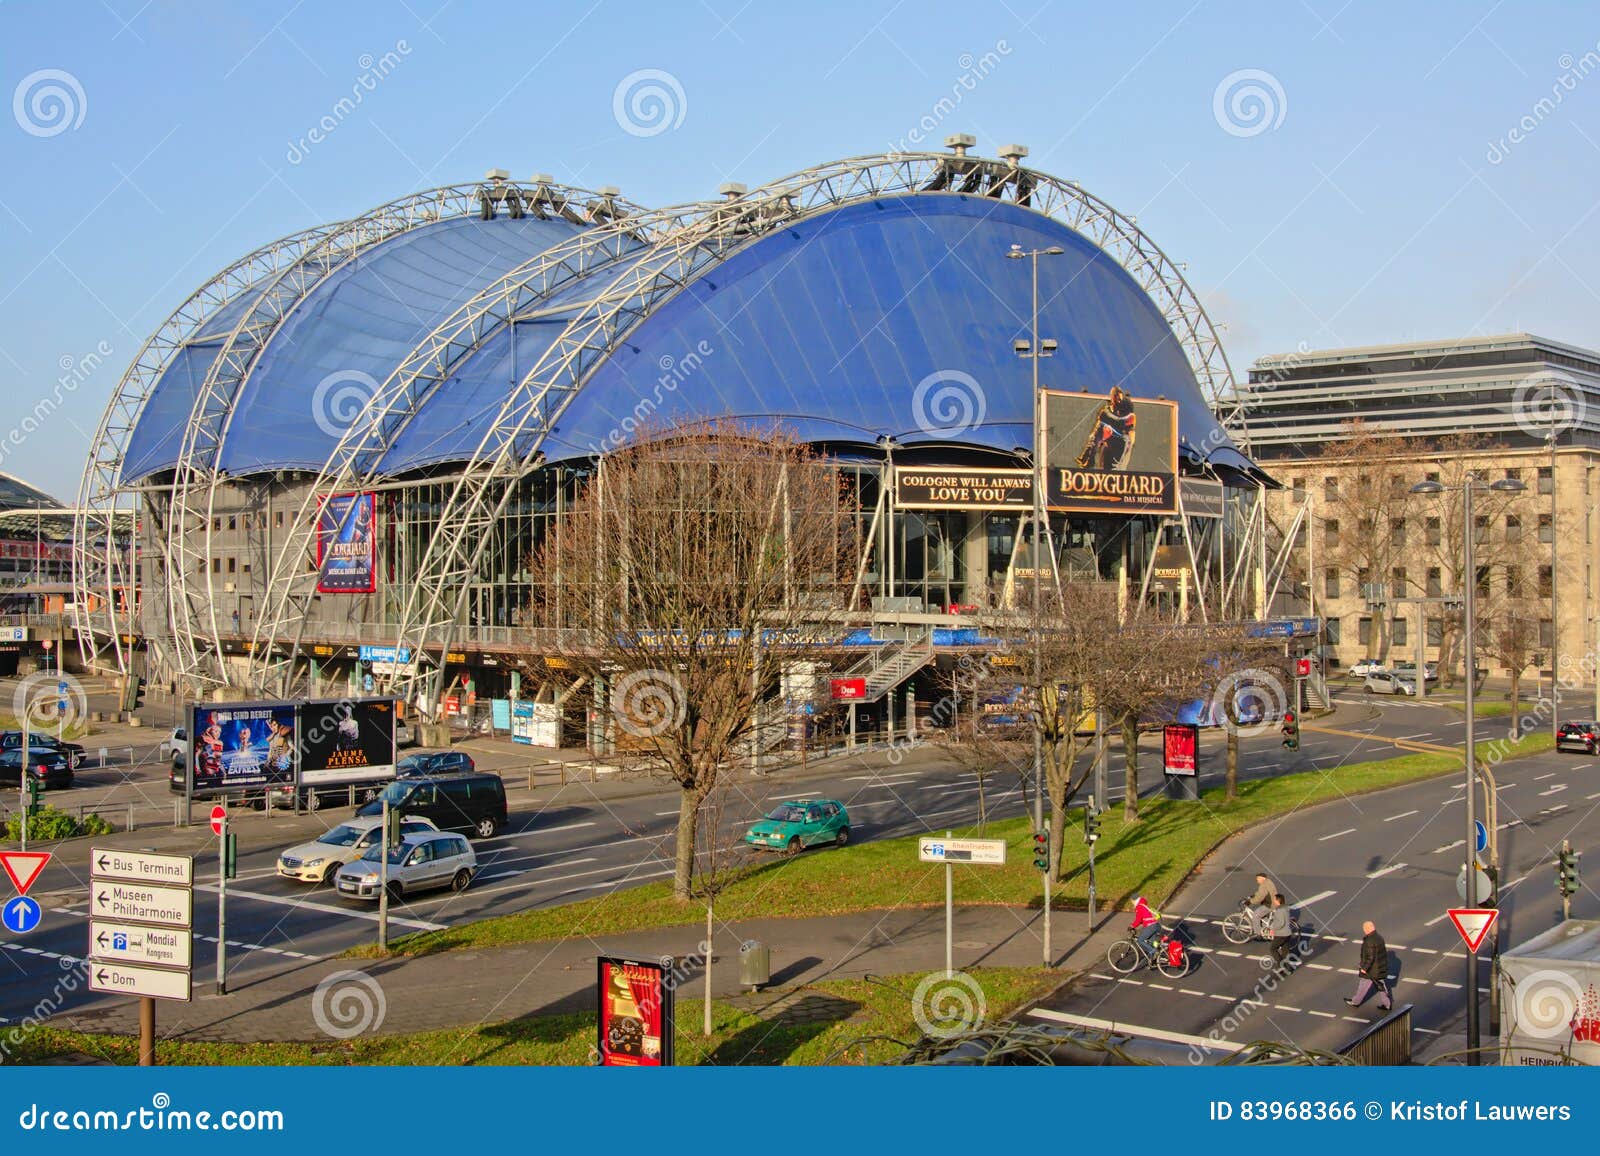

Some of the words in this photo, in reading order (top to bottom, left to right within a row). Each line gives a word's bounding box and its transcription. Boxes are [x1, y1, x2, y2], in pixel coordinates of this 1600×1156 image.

[902, 475, 958, 487] COLOGNE
[960, 476, 989, 488] WILL
[990, 478, 1031, 489] ALWAYS
[1060, 469, 1164, 496] BODYGUARD
[929, 487, 970, 501] LOVE
[973, 488, 1006, 501] YOU
[1123, 495, 1136, 503] DAS
[1137, 496, 1164, 504] MUSICAL
[328, 755, 367, 766] PLENSA
[331, 749, 363, 758] JAUME
[113, 858, 133, 872] Bus
[138, 860, 184, 876] Terminal
[113, 888, 153, 902] Museen
[113, 902, 182, 920] Philharmonie
[146, 932, 177, 947] Mondial
[146, 947, 173, 959] Kongress
[112, 972, 136, 986] Dom
